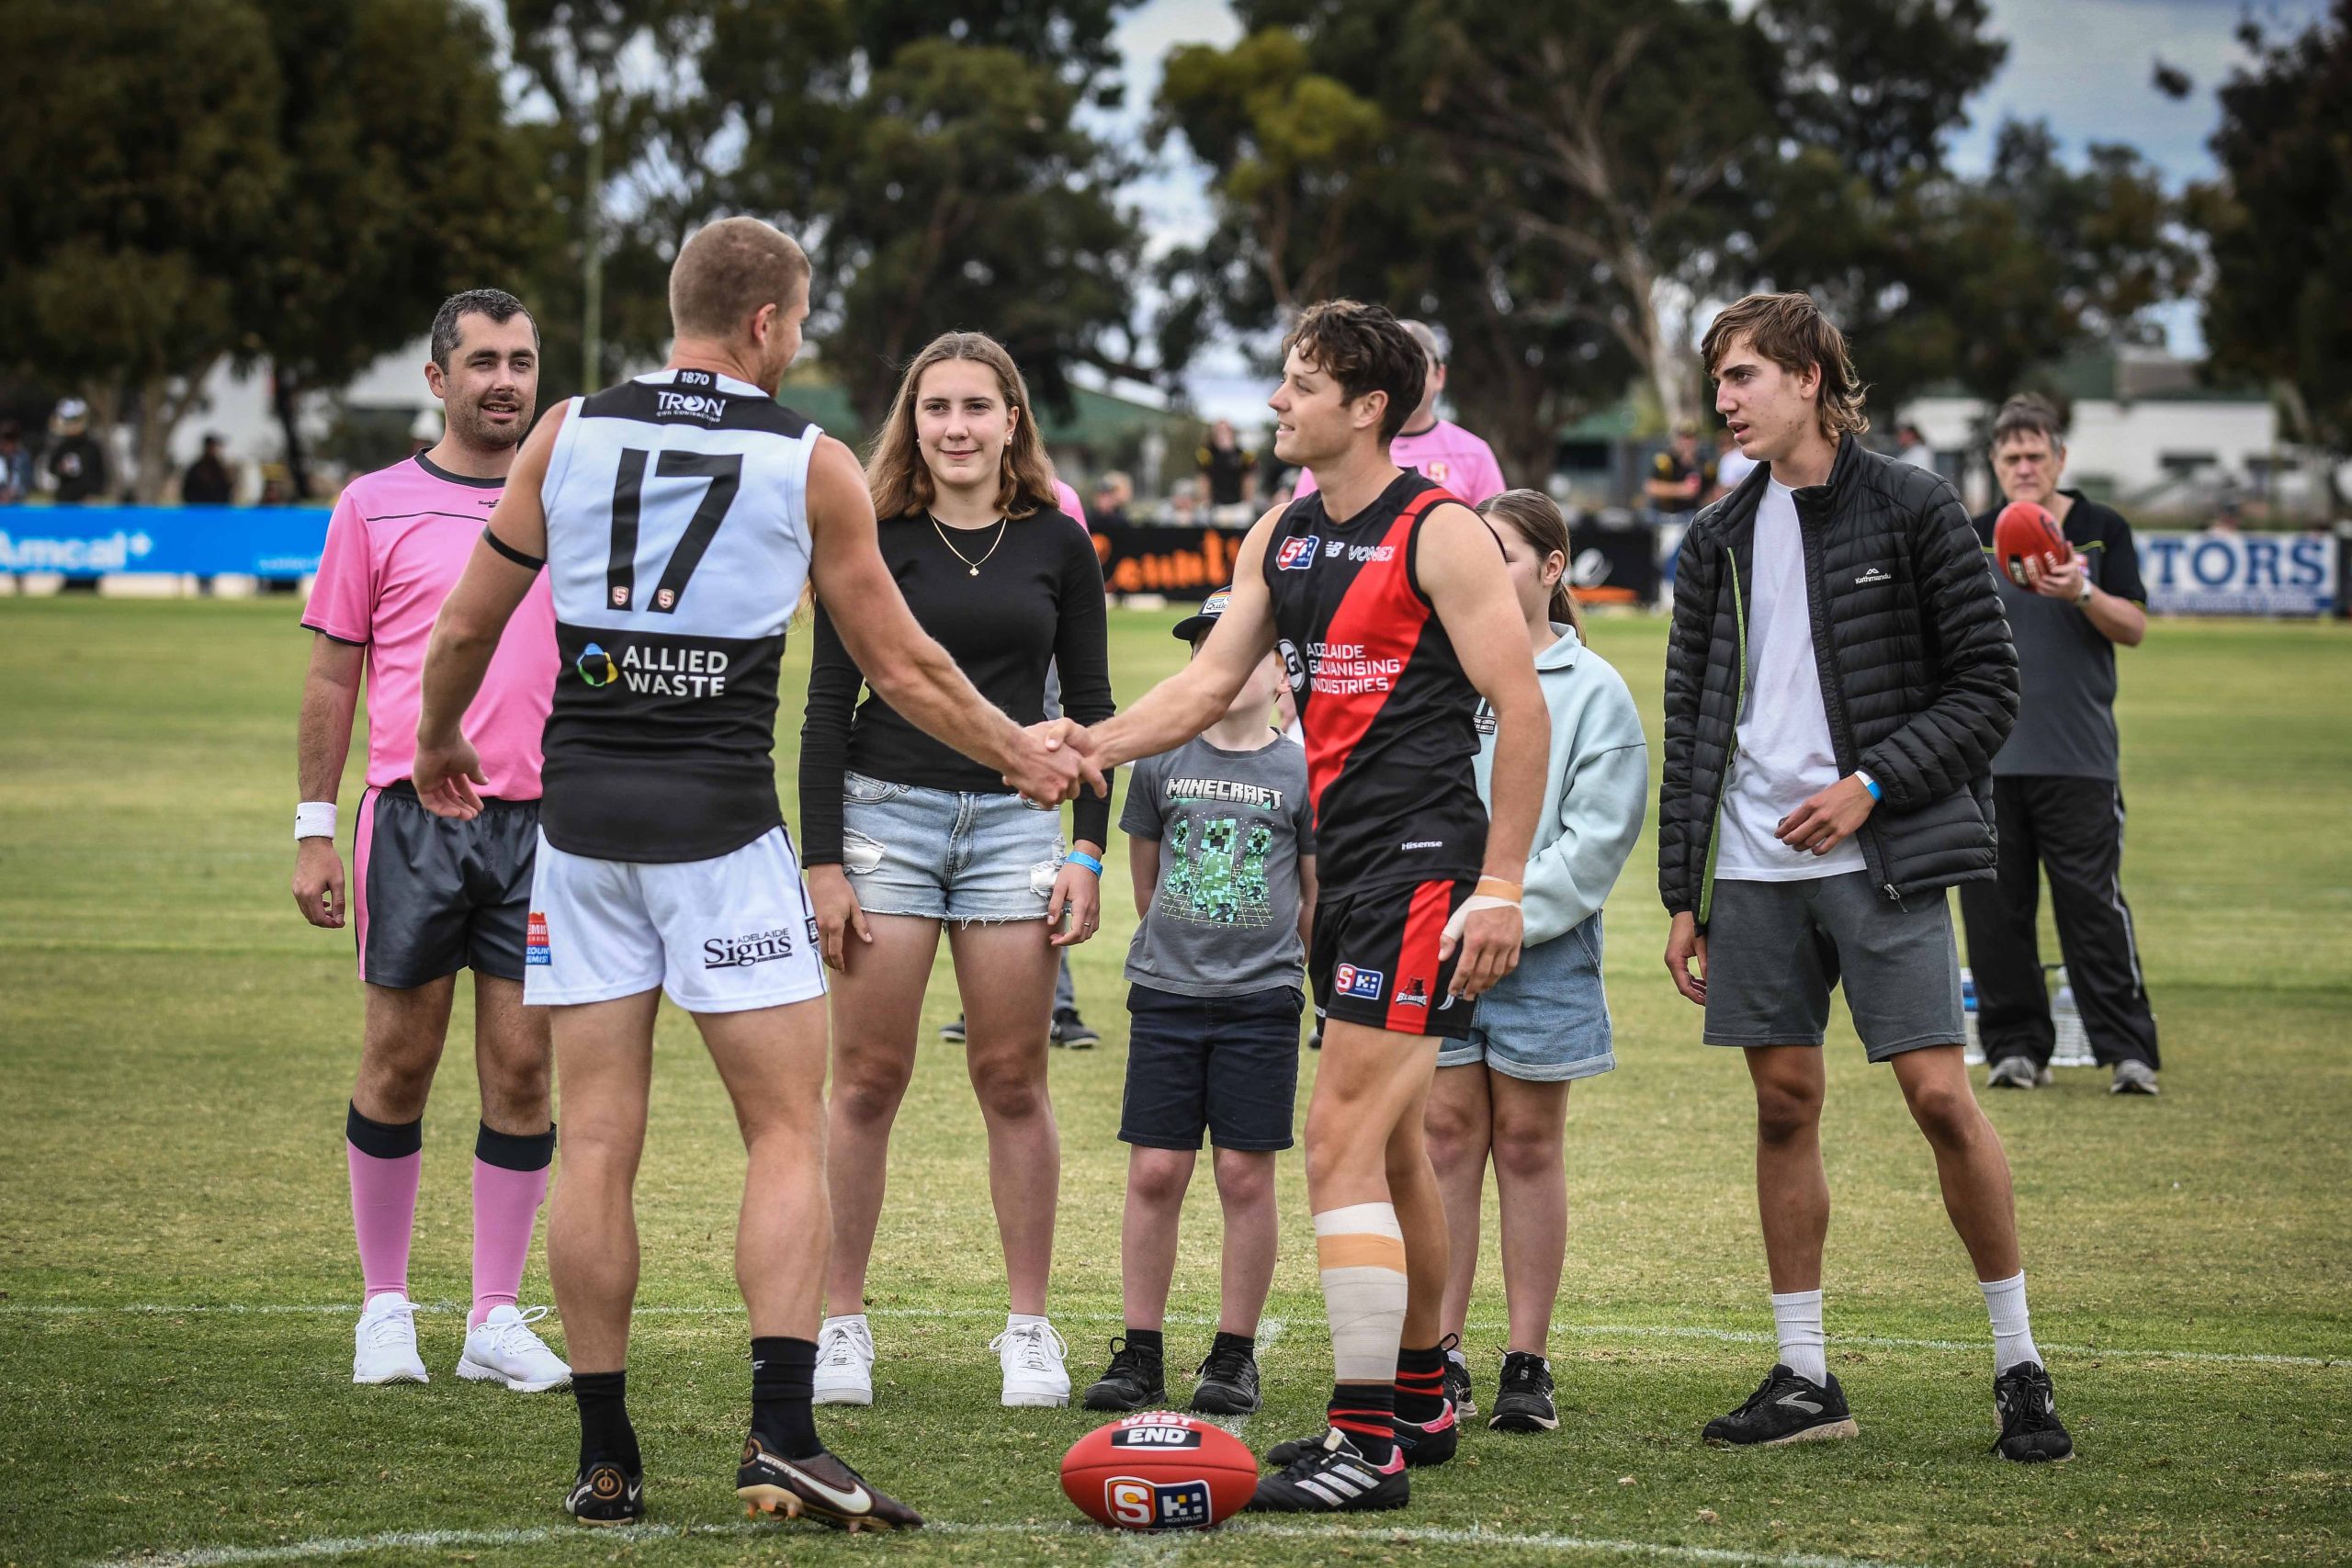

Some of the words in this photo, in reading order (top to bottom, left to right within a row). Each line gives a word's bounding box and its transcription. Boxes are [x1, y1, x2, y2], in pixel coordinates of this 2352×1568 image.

[681, 371, 709, 385] 1870
[658, 391, 726, 417] TRON
[606, 447, 744, 614] 17
[1348, 545, 1396, 562] VONEX
[2137, 539, 2325, 586] TORS
[1855, 573, 1891, 584] Kathmandu
[622, 645, 729, 673] ALLIED
[1306, 643, 1366, 659] ADELAIDE
[1308, 659, 1400, 676] GALVANISING
[624, 671, 726, 697] WASTE
[1310, 677, 1388, 694] INDUSTRIES
[1165, 778, 1283, 810] MINECRAFT
[1401, 840, 1443, 851] Hisense
[738, 928, 788, 943] ADELAIDE
[704, 936, 792, 966] Signs
[1121, 1415, 1196, 1427] WEST
[1126, 1427, 1187, 1444] END
[1164, 1515, 1204, 1523] HOSTPLUS
